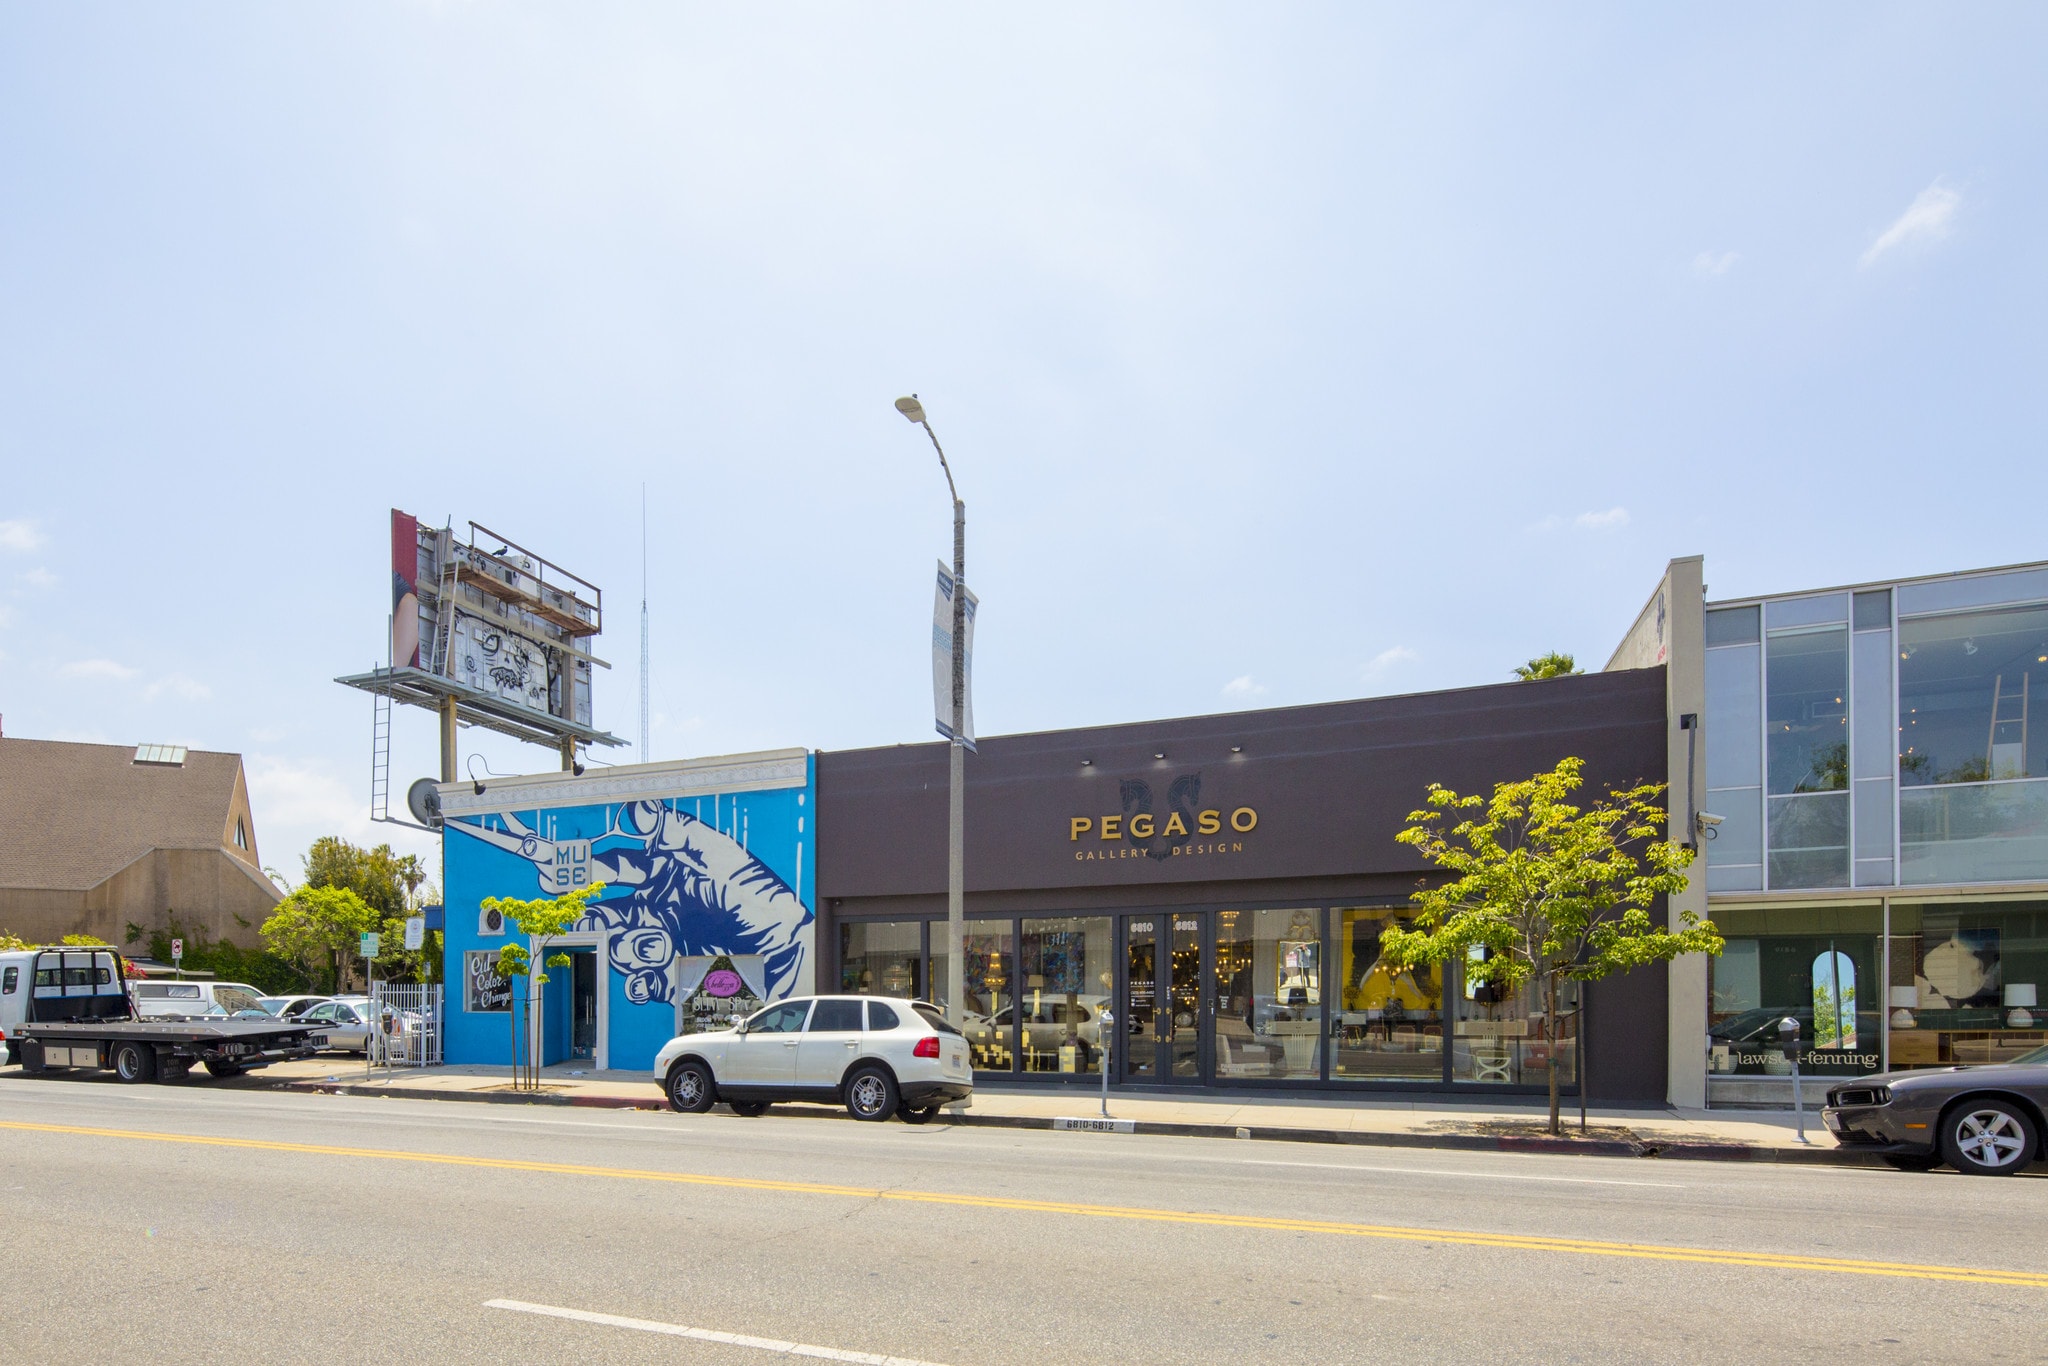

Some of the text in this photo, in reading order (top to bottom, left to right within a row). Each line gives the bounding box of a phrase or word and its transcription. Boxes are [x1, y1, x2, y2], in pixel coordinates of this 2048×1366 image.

[1070, 807, 1258, 841] PEGASO
[556, 845, 586, 865] MU
[1075, 842, 1243, 861] GALLERY DESIGN
[556, 867, 586, 886] SE
[1130, 922, 1153, 932] 6810
[1175, 920, 1198, 931] 6812
[481, 990, 512, 1008] Change
[1066, 1120, 1114, 1131] 6810-6812
